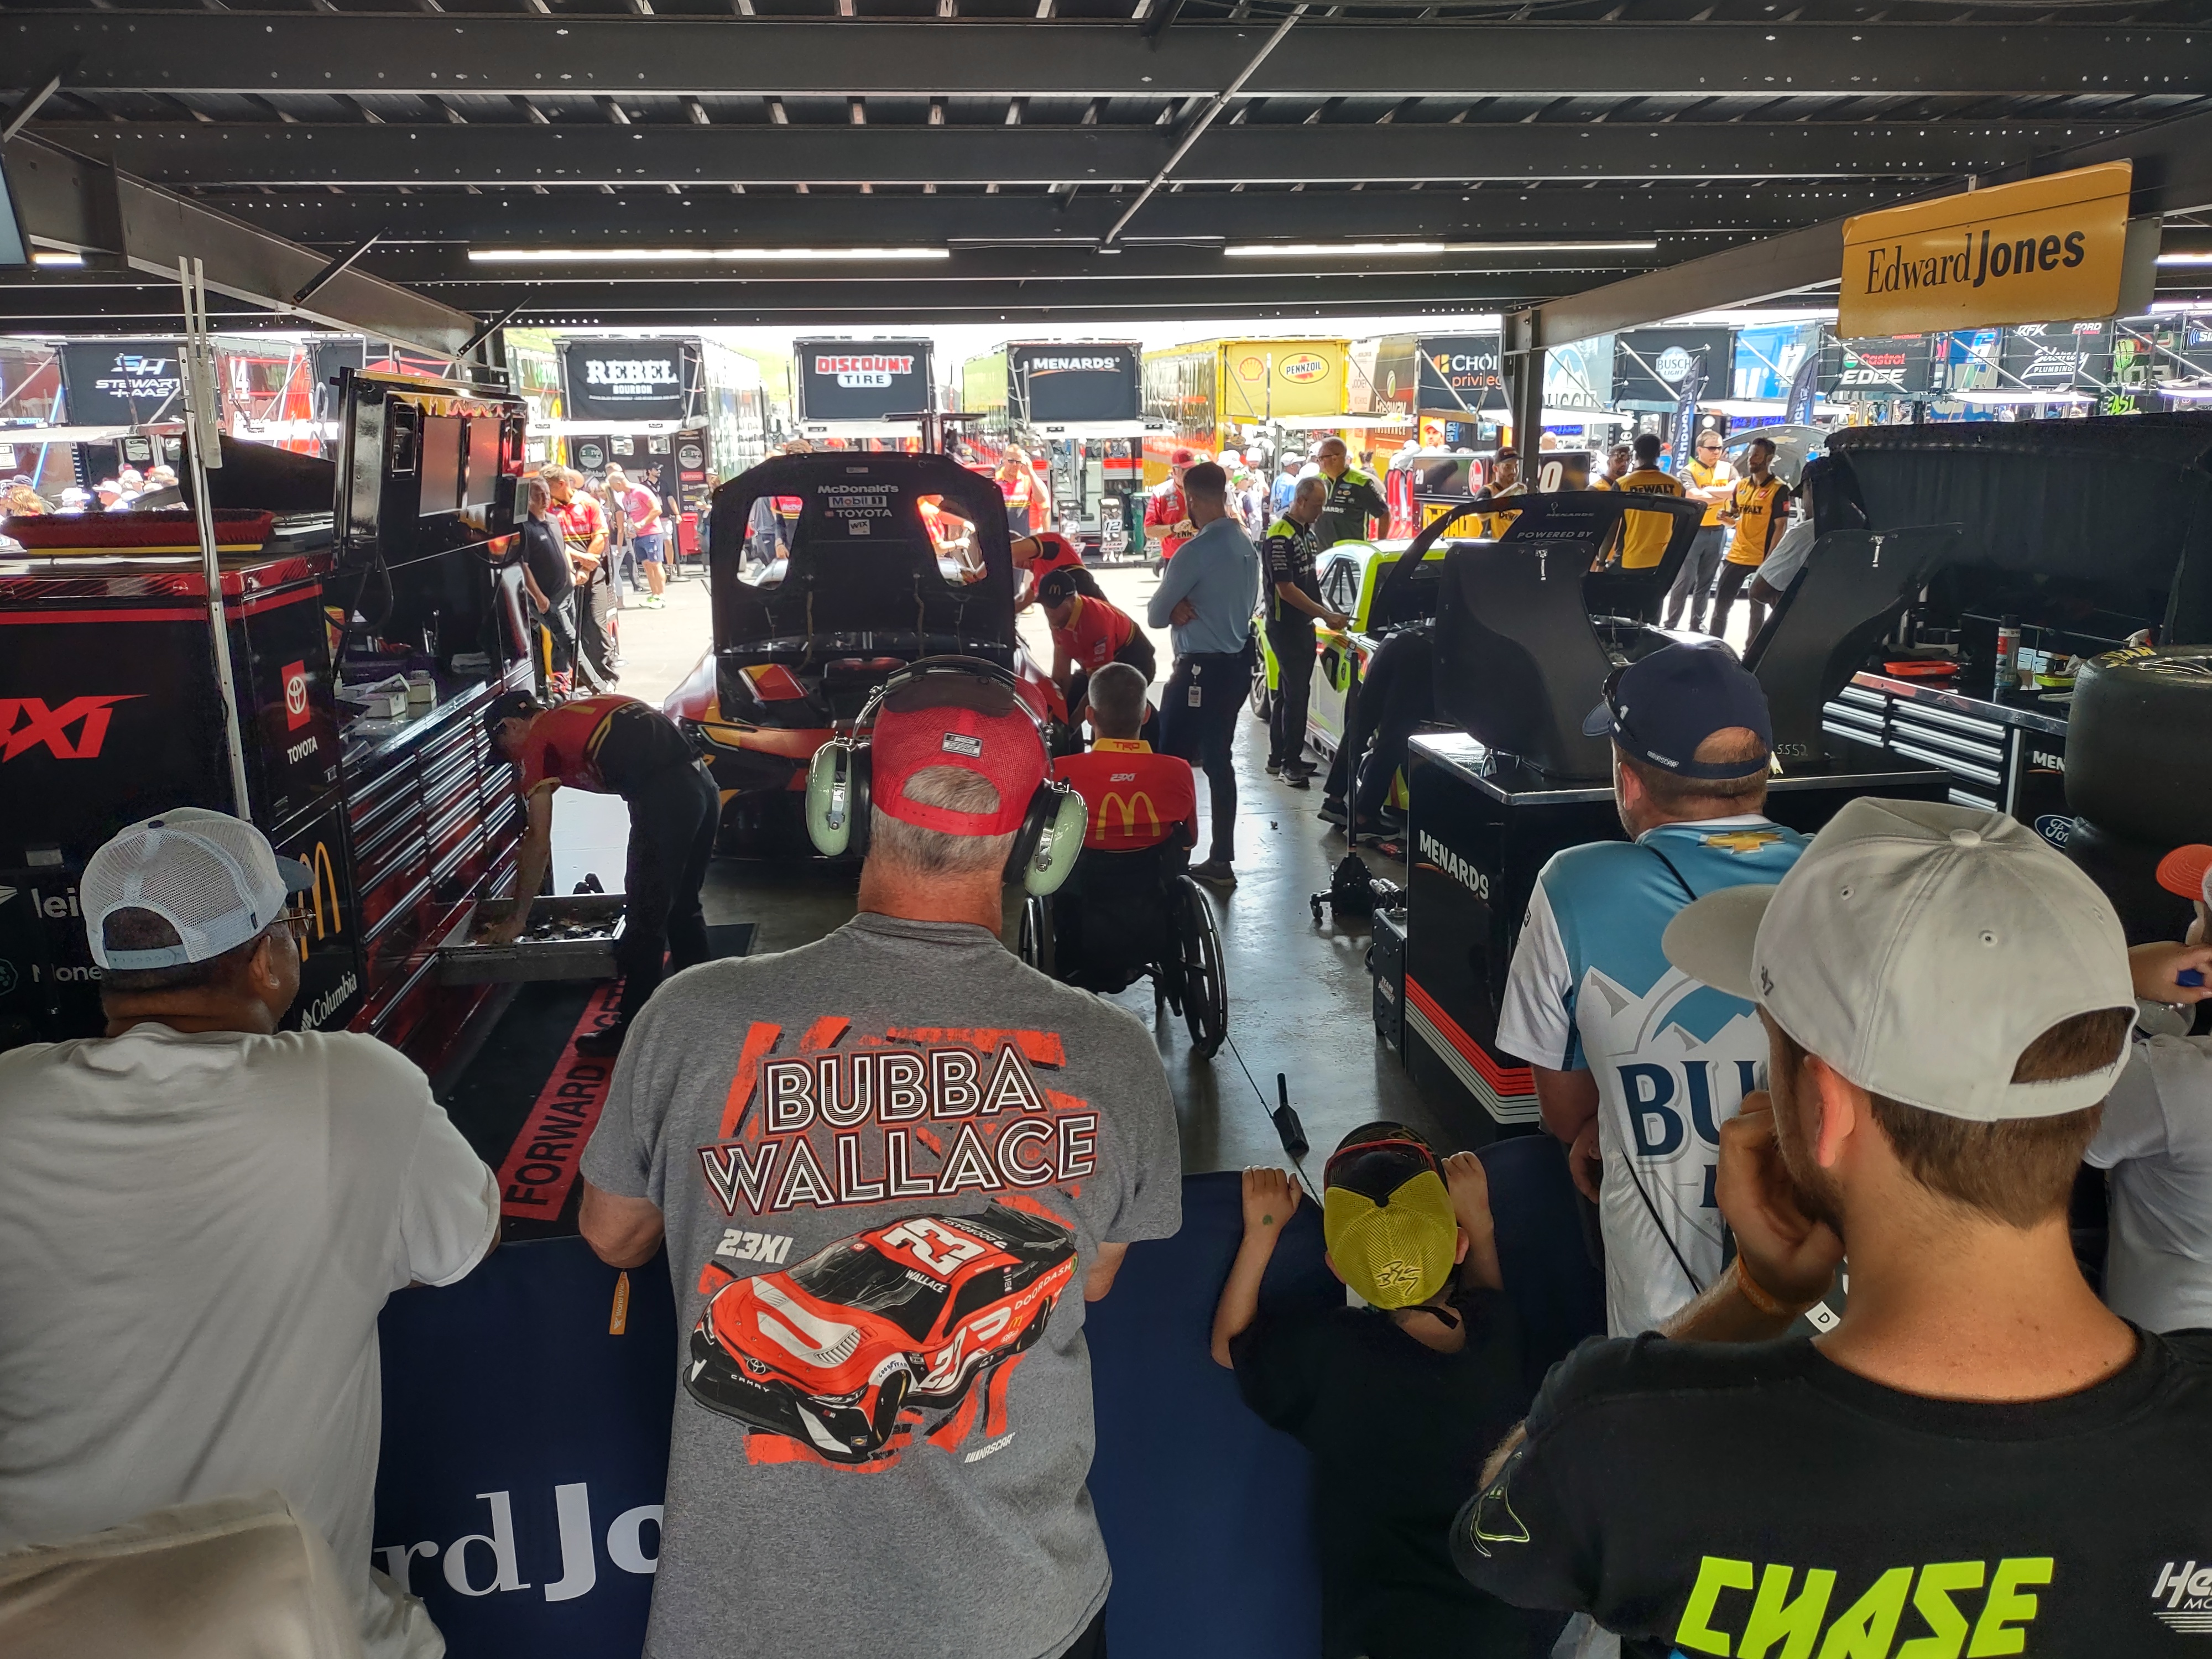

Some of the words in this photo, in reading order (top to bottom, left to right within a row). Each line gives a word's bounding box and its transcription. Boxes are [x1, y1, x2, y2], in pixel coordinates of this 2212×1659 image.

[2017, 324, 2048, 336] RFK
[2072, 322, 2101, 331] FORD
[816, 357, 912, 374] DISCOUNT
[1033, 358, 1115, 369] MENARDS
[1657, 358, 1691, 372] BUSCH
[1860, 353, 1906, 366] Castrol
[586, 359, 680, 385] REBEL
[1286, 362, 1322, 375] PENNZOIL
[1840, 368, 1907, 385] EDGE
[95, 378, 180, 389] STEWART
[844, 375, 885, 384] TIRE
[613, 385, 653, 394] BOURBON
[1415, 469, 1425, 484] 20
[817, 484, 899, 493] McDonald's
[1630, 484, 1675, 495] DEWALT
[836, 509, 893, 518] TOYOTA
[286, 736, 318, 765] TOYOTA
[1776, 743, 1809, 757] 5552
[1420, 829, 1489, 900] MENARDS
[311, 973, 358, 1026] Columbia
[763, 1042, 1047, 1136] BUBBA
[503, 1065, 607, 1206] FORWARD
[698, 1113, 1098, 1217] WALLACE
[715, 1228, 794, 1265] 23XI
[882, 1218, 986, 1276] 23
[905, 1269, 947, 1293] WALLACE
[1014, 1261, 1072, 1311] DOORDASH
[731, 1374, 770, 1392] CAMRY
[964, 1434, 1013, 1463] NASCAR
[1674, 1556, 2053, 1659] CHASE
